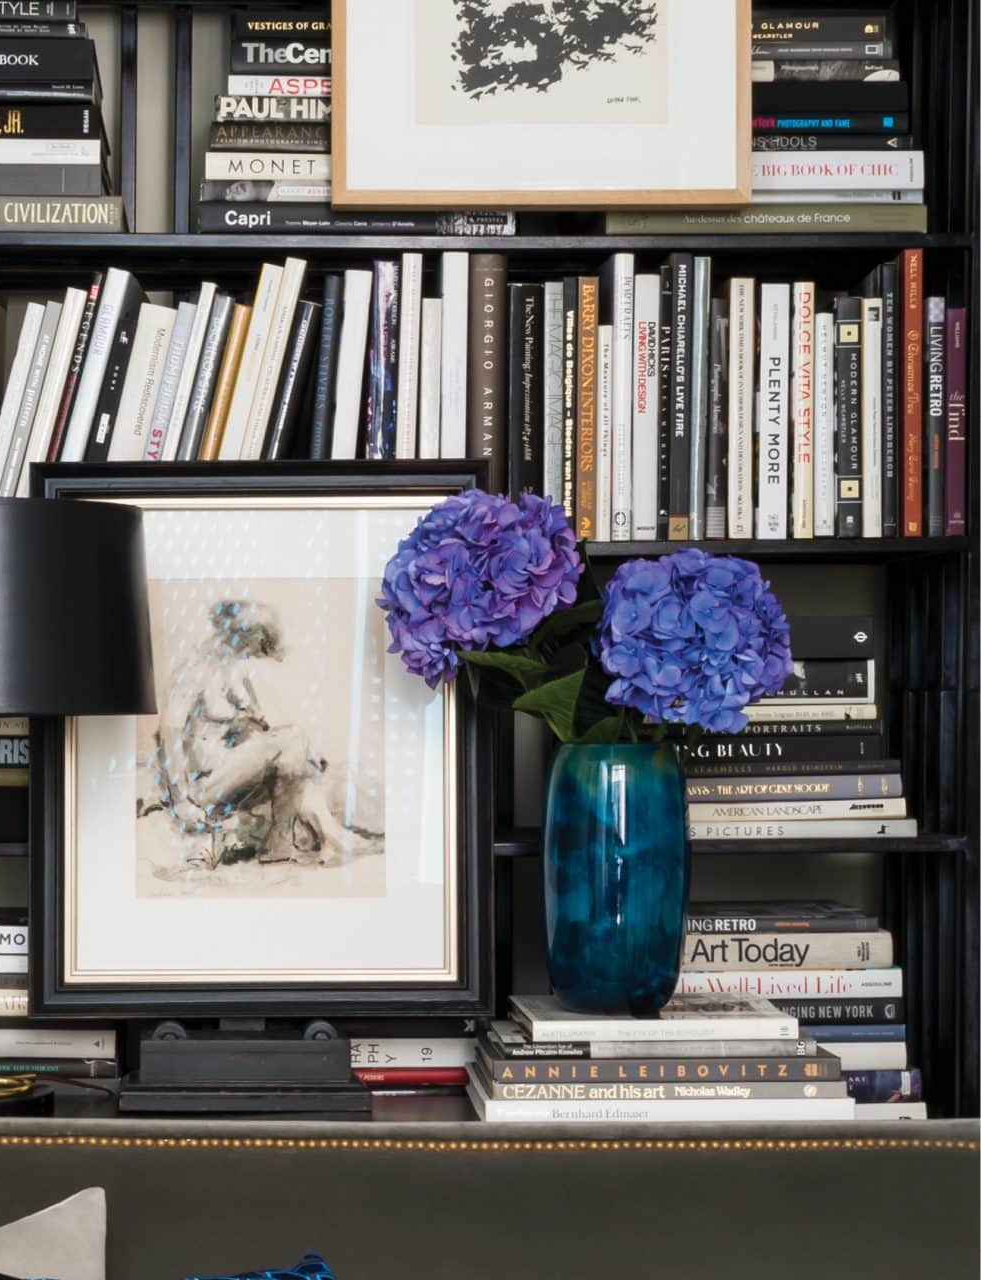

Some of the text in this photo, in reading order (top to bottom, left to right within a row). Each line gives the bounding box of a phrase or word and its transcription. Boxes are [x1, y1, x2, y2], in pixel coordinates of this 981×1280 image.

[247, 22, 309, 30] VESTIGES OF
[761, 22, 819, 30] GLAMOUR
[0, 54, 39, 66] BOOK
[218, 96, 284, 121] PAUL
[777, 119, 818, 129] PHOTOGRAPHY
[821, 119, 833, 128] AND
[835, 119, 850, 128] FAME
[228, 159, 316, 175] MONET
[762, 164, 787, 176] BIG
[791, 164, 834, 176] BOOK
[836, 164, 856, 176] OF
[861, 164, 898, 176] CHIC
[4, 202, 108, 224] CIVILIZATION
[225, 210, 271, 228] Capri
[744, 212, 850, 224] châteaux de France
[910, 256, 918, 278] NELL
[524, 297, 535, 335] The New
[580, 284, 595, 332] BARRY
[69, 301, 96, 373] LEGENDS
[144, 326, 168, 378] Modernism
[647, 321, 656, 376] DAVID HICKS
[661, 326, 671, 372] PARIS
[675, 264, 687, 437] MICHAEL CHIARELLO'S LIVE FIRE
[482, 278, 494, 456] GIORGIO ARMAN
[580, 336, 595, 387] DIXON
[637, 321, 647, 413] LIVING WITH DESIGN
[886, 361, 893, 373] BY
[930, 327, 943, 416] LIVING RETRO
[798, 292, 811, 463] DOLCE VITA STYLE
[17, 388, 36, 427] pattern
[850, 354, 858, 470] MODERN GLAMOUR
[565, 361, 575, 479] Belgique van
[768, 357, 781, 485] PLENTY MORE
[948, 402, 966, 441] find
[580, 392, 595, 472] INTERIORS
[745, 724, 822, 734] PORTRAITS
[712, 805, 823, 817] AMERICAN LANDSCAPE
[707, 826, 785, 837] PICTURES
[716, 919, 756, 931] RETRO
[691, 938, 810, 966] Art Today
[817, 975, 853, 993] Life
[819, 1005, 873, 1018] NEW YORK
[421, 1047, 433, 1062] 19
[502, 1064, 787, 1078] ANNIE LEIBOVITZ
[503, 1084, 751, 1099] CEZANNE and his art Nicholas Wadley
[552, 1110, 603, 1119] Bernhard
